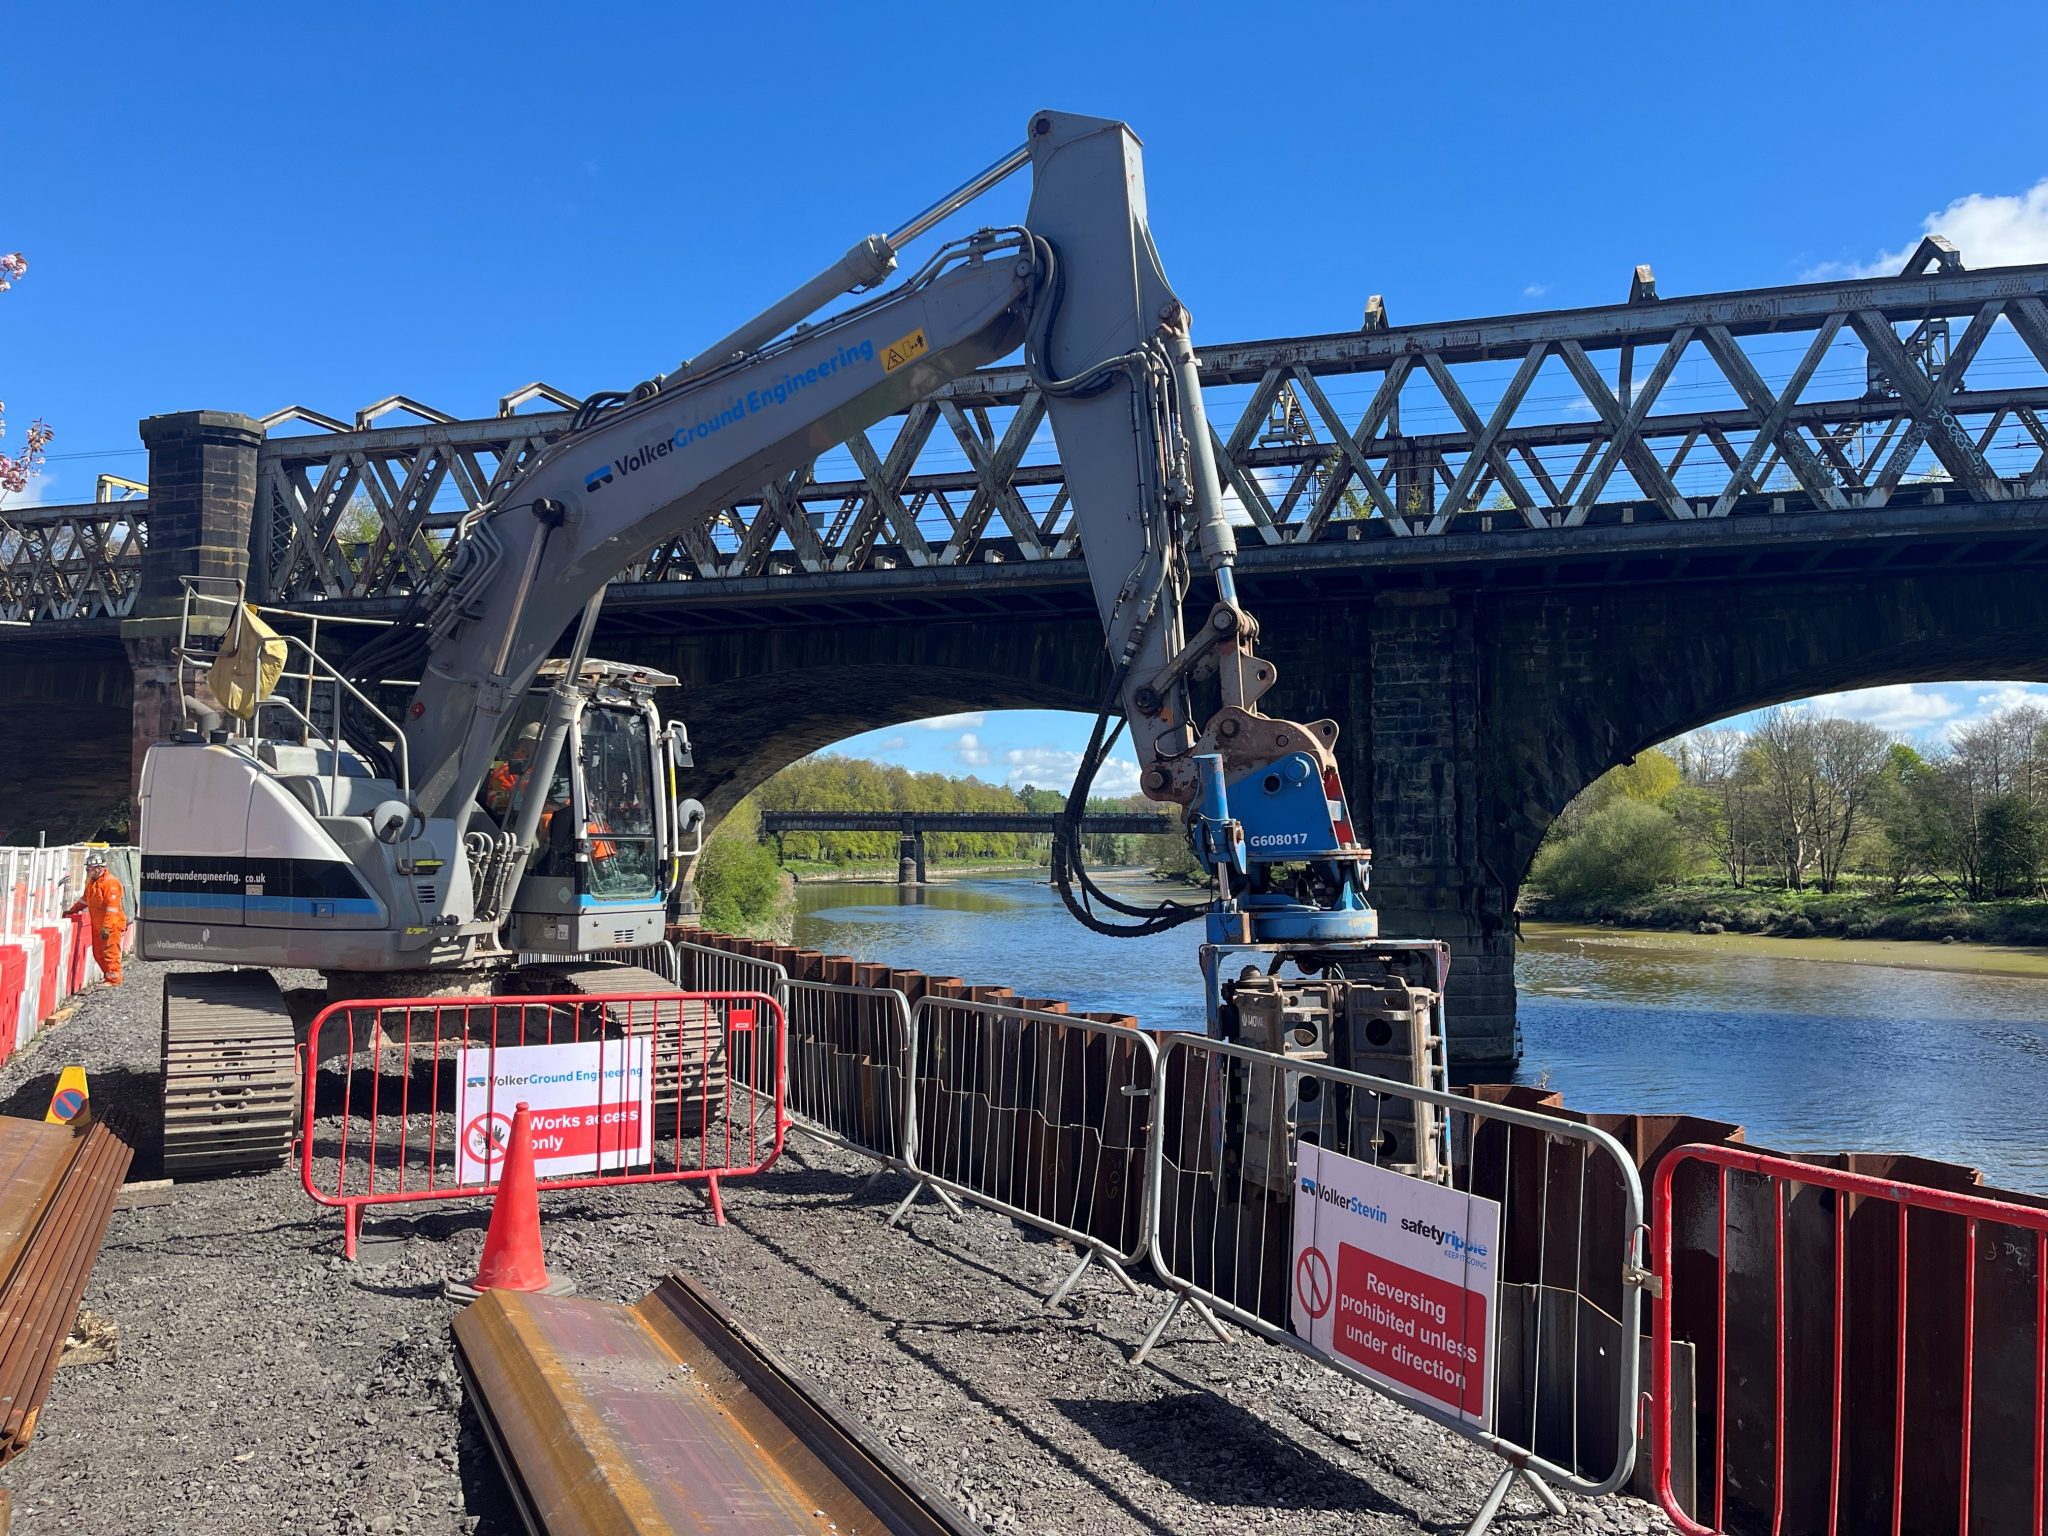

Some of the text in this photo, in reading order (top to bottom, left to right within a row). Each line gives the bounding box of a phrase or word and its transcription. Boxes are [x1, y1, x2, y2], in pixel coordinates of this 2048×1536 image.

[747, 338, 874, 414] Engineering
[1250, 833, 1308, 846] G608017
[576, 1067, 643, 1082] Engneerng
[530, 1114, 581, 1130] Works
[1317, 1182, 1387, 1224] VolkerStevin
[1444, 1250, 1459, 1259] KEEP
[1366, 1272, 1446, 1324] Reversing
[1341, 1293, 1477, 1363] prohibited unless
[1346, 1324, 1466, 1390] under direction
